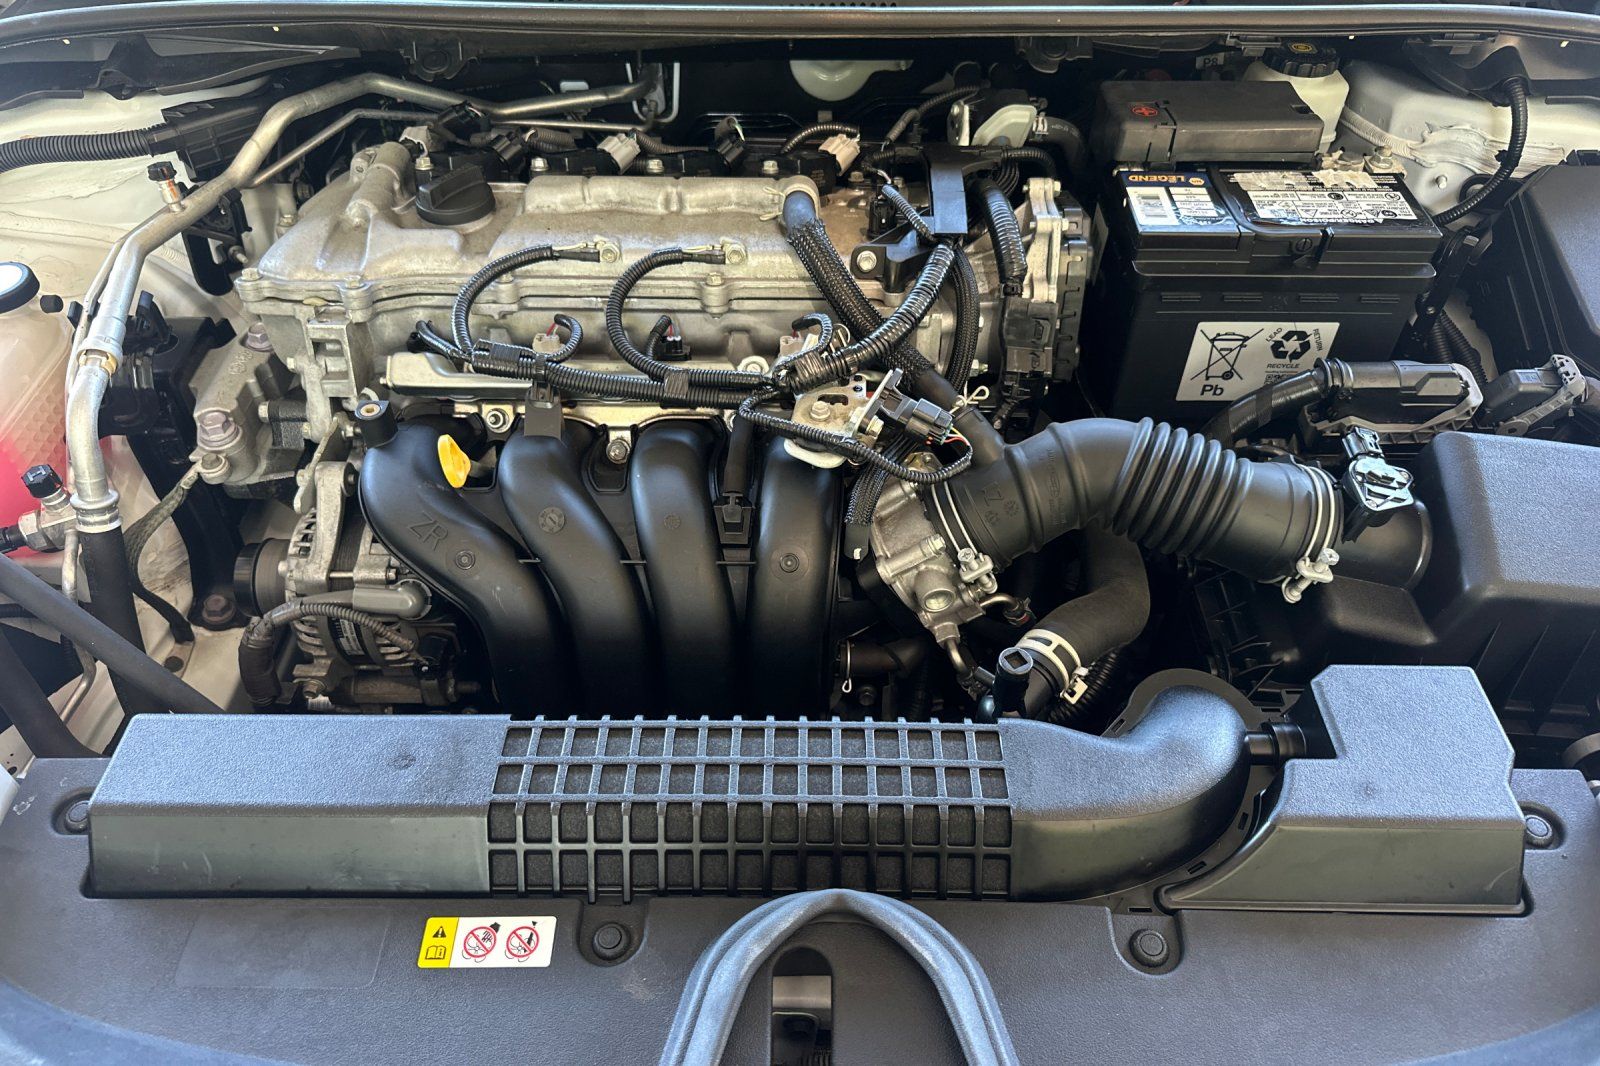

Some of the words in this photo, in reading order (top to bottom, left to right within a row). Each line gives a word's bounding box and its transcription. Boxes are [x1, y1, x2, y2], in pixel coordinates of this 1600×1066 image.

[1129, 175, 1185, 183] LEGEND
[1266, 328, 1282, 342] LEAD
[1313, 328, 1323, 351] RETURN
[1200, 384, 1224, 396] Pb
[407, 511, 449, 551] ZR
